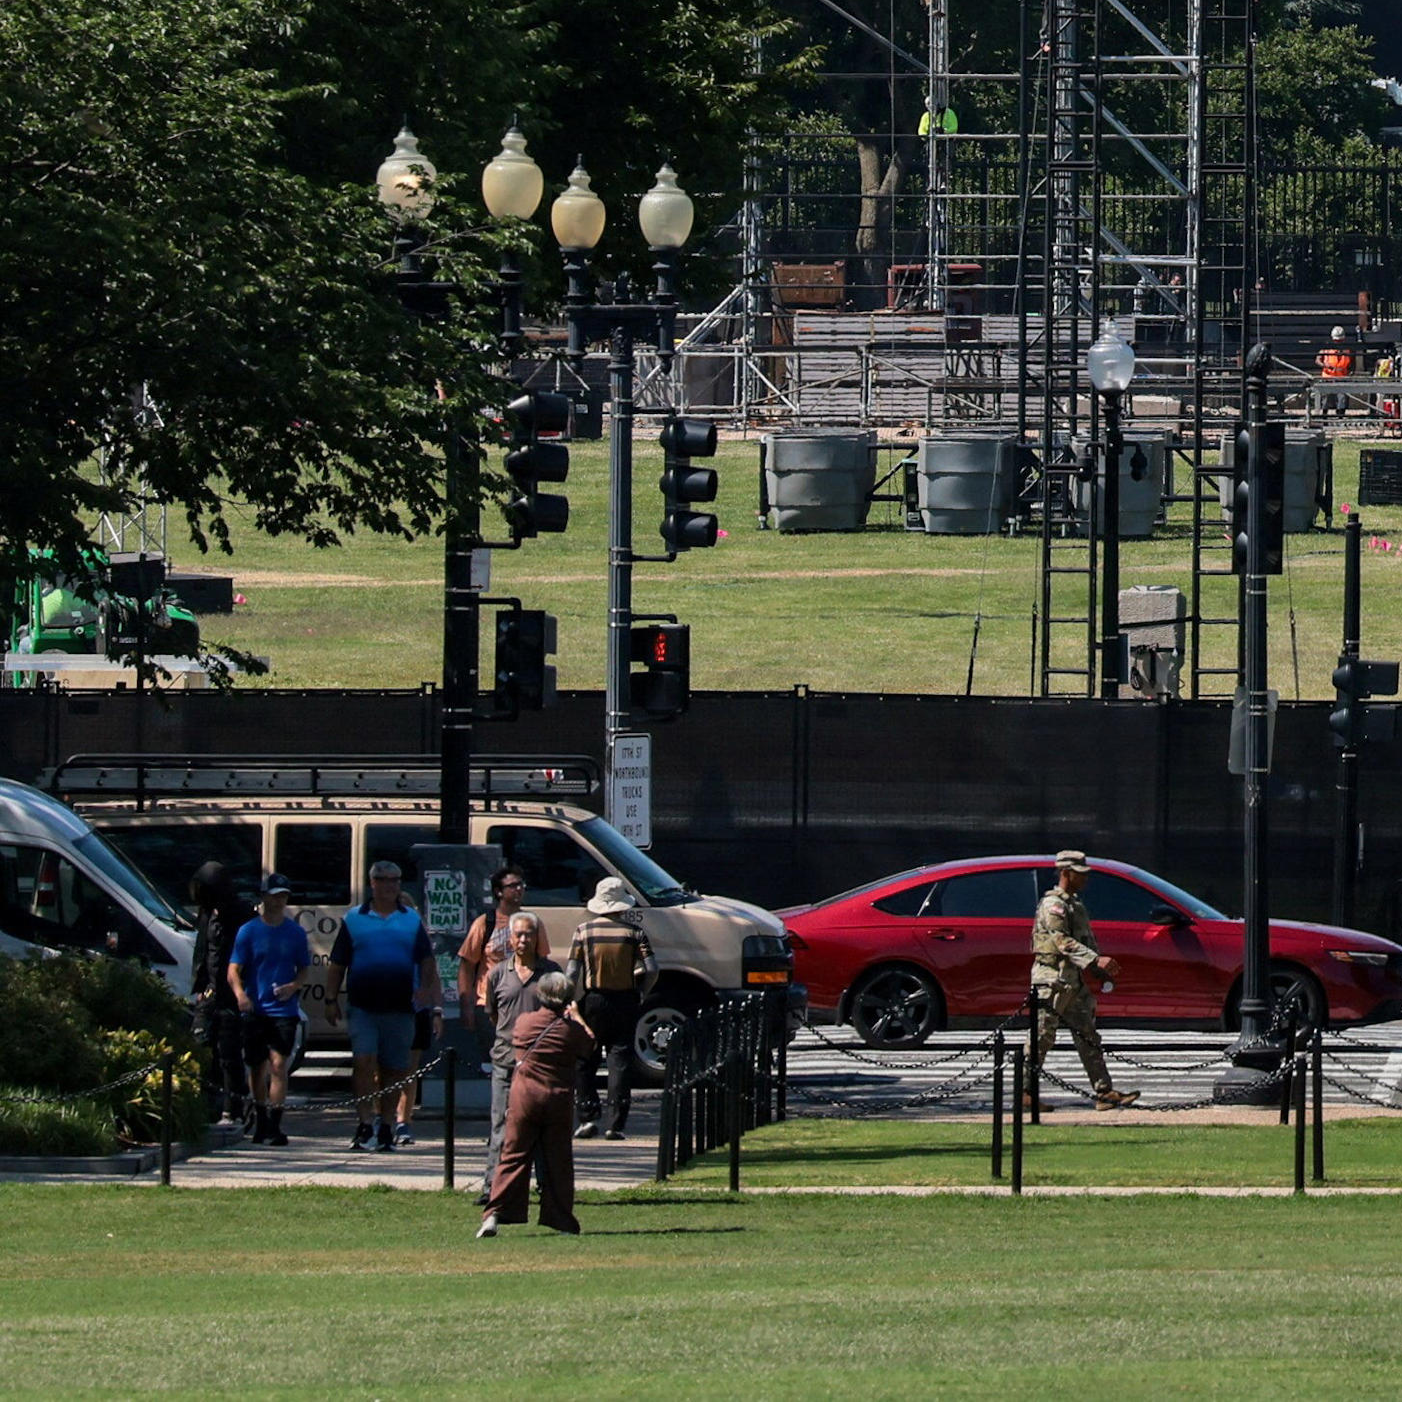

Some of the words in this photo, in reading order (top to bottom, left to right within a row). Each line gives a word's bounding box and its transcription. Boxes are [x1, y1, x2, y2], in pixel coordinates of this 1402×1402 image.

[622, 786, 642, 798] TRUCKS
[626, 805, 637, 818] USE
[427, 890, 464, 907] WAR
[430, 913, 460, 926] IRAN
